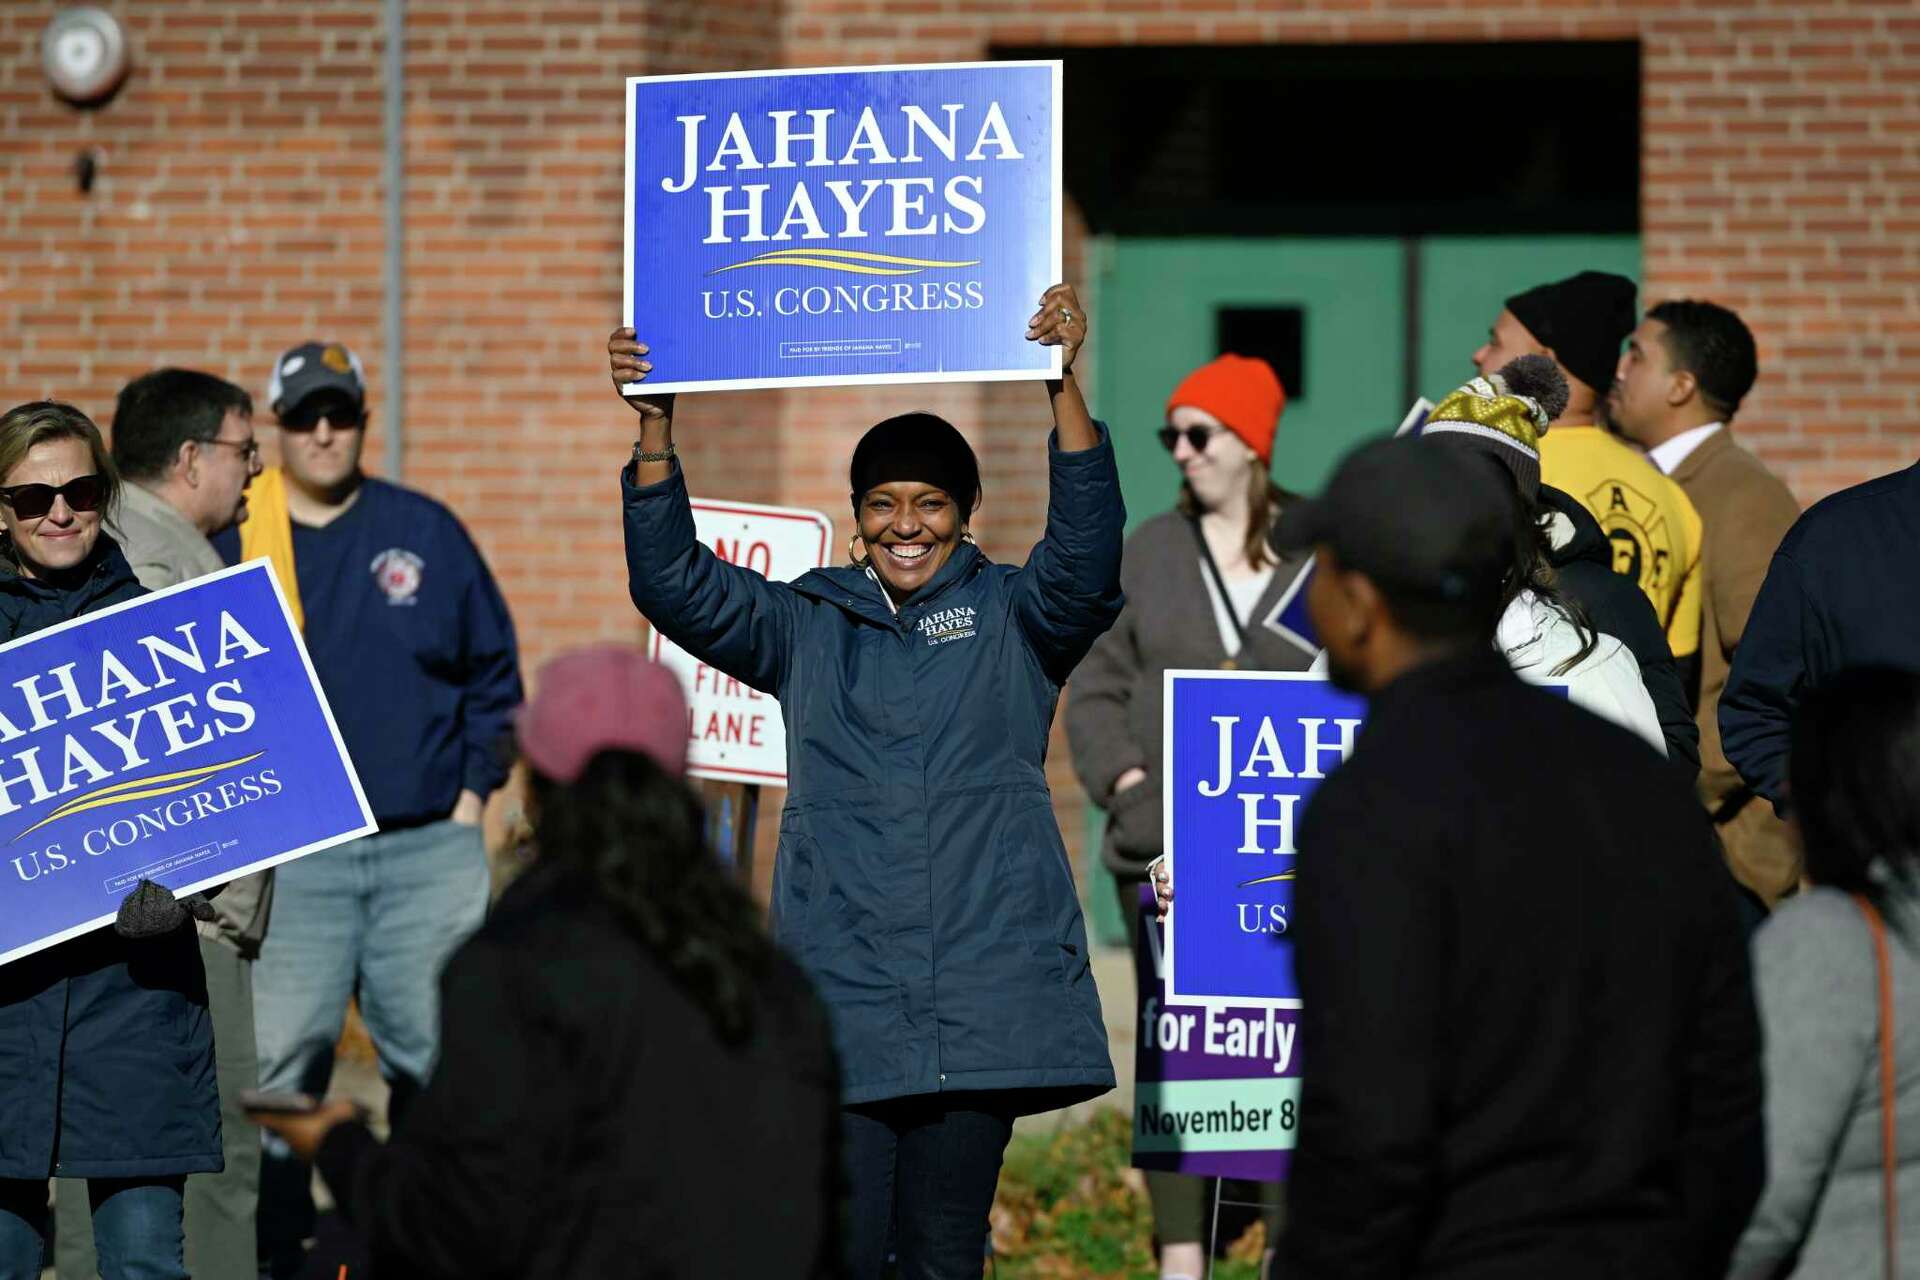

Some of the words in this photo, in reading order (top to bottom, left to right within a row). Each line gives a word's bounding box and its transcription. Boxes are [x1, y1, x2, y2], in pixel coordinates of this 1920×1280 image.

[661, 101, 1025, 193] JAHANA
[702, 175, 987, 245] HAYES
[702, 289, 762, 319] U.S.
[774, 281, 984, 316] CONGRESS
[1610, 486, 1629, 512] A
[917, 607, 976, 631] JAHANA
[925, 617, 973, 636] HAYES
[940, 630, 976, 643] CONGRESS
[688, 707, 765, 746] LANE
[0, 678, 257, 816] HAYES
[10, 843, 76, 881] U.S.
[83, 769, 283, 856] CONGRESS
[1142, 998, 1196, 1052] for
[1204, 1005, 1297, 1074] Early
[1140, 1100, 1273, 1136] November
[1280, 1099, 1296, 1131] 8
